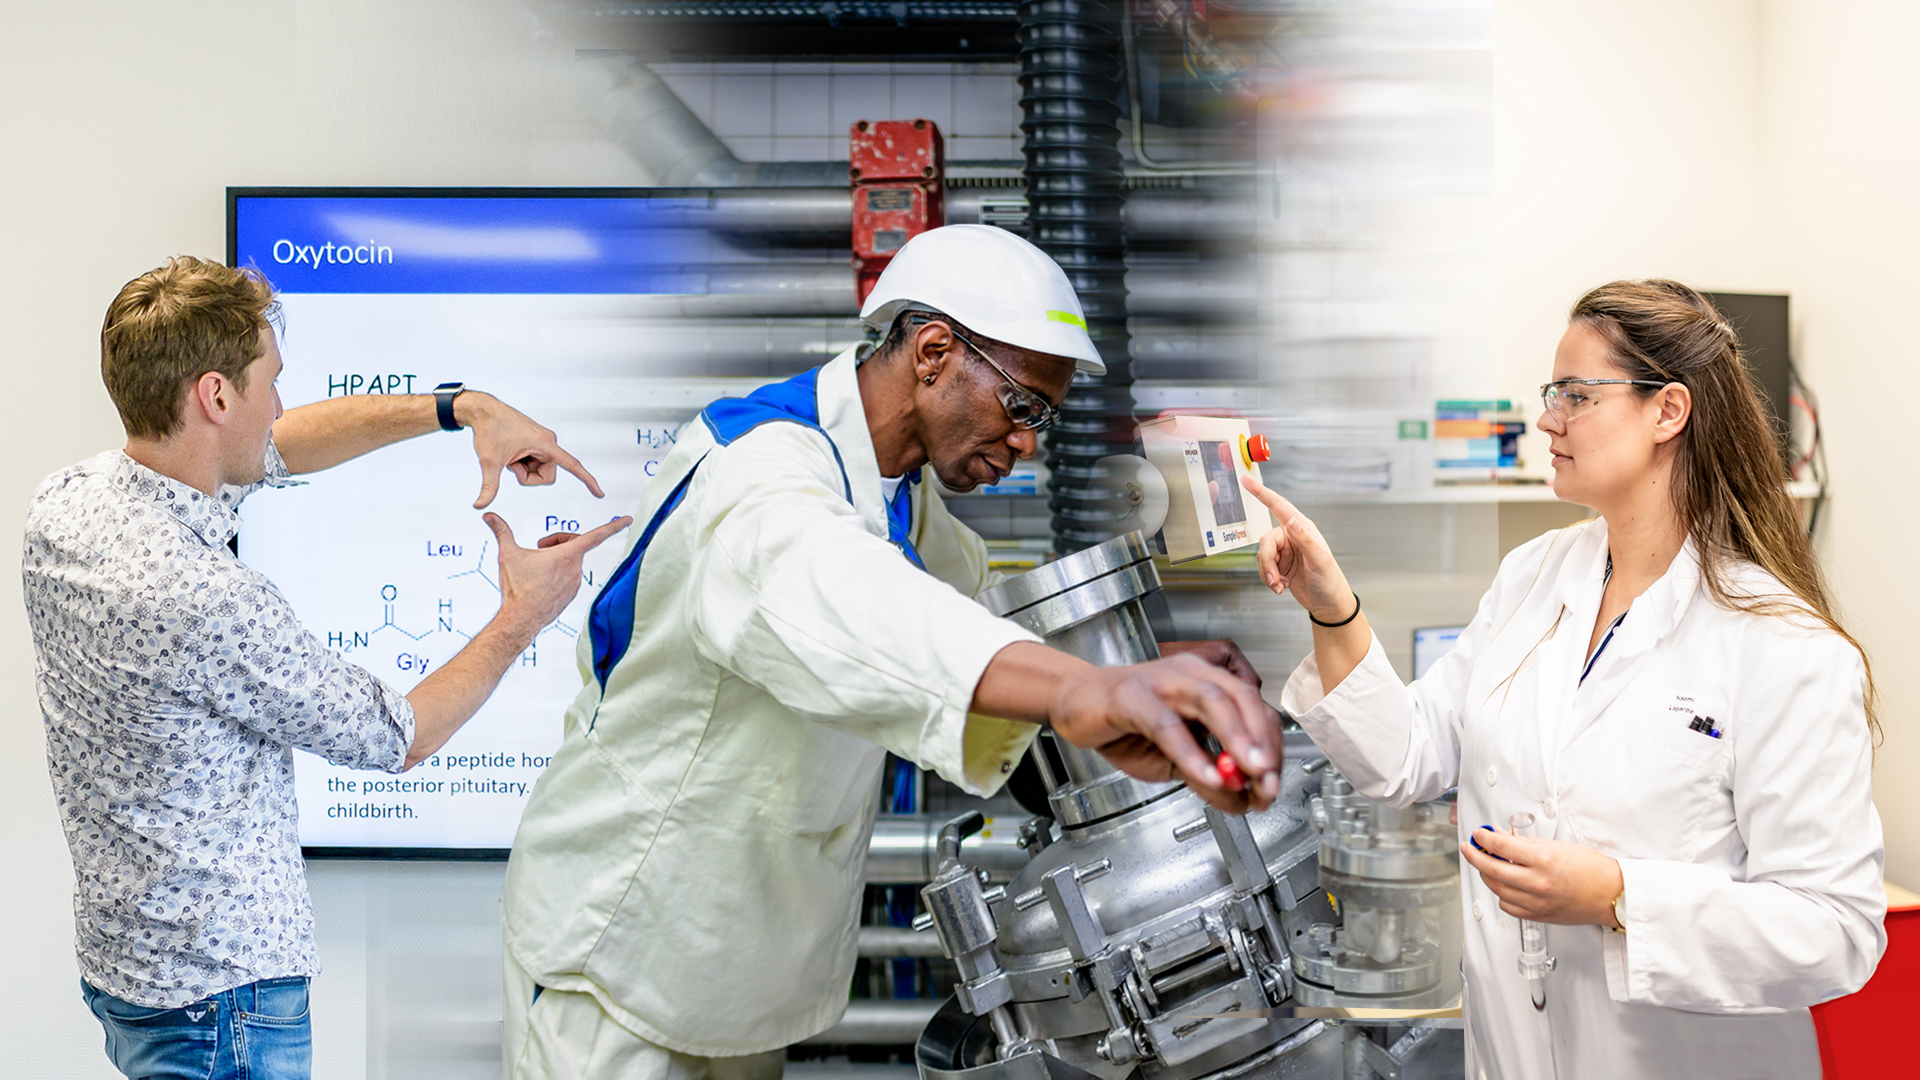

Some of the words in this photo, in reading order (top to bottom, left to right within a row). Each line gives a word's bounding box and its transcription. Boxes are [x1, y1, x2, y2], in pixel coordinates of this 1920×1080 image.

[273, 239, 393, 270] Oxytocin
[546, 515, 579, 533] Pro
[427, 540, 462, 557] Leu
[396, 652, 430, 675] Gly
[431, 755, 440, 767] a
[447, 752, 515, 770] peptide
[327, 778, 357, 792] the
[363, 777, 444, 796] posterior
[450, 778, 530, 797] pituitary.
[327, 803, 418, 819] childbirth.
